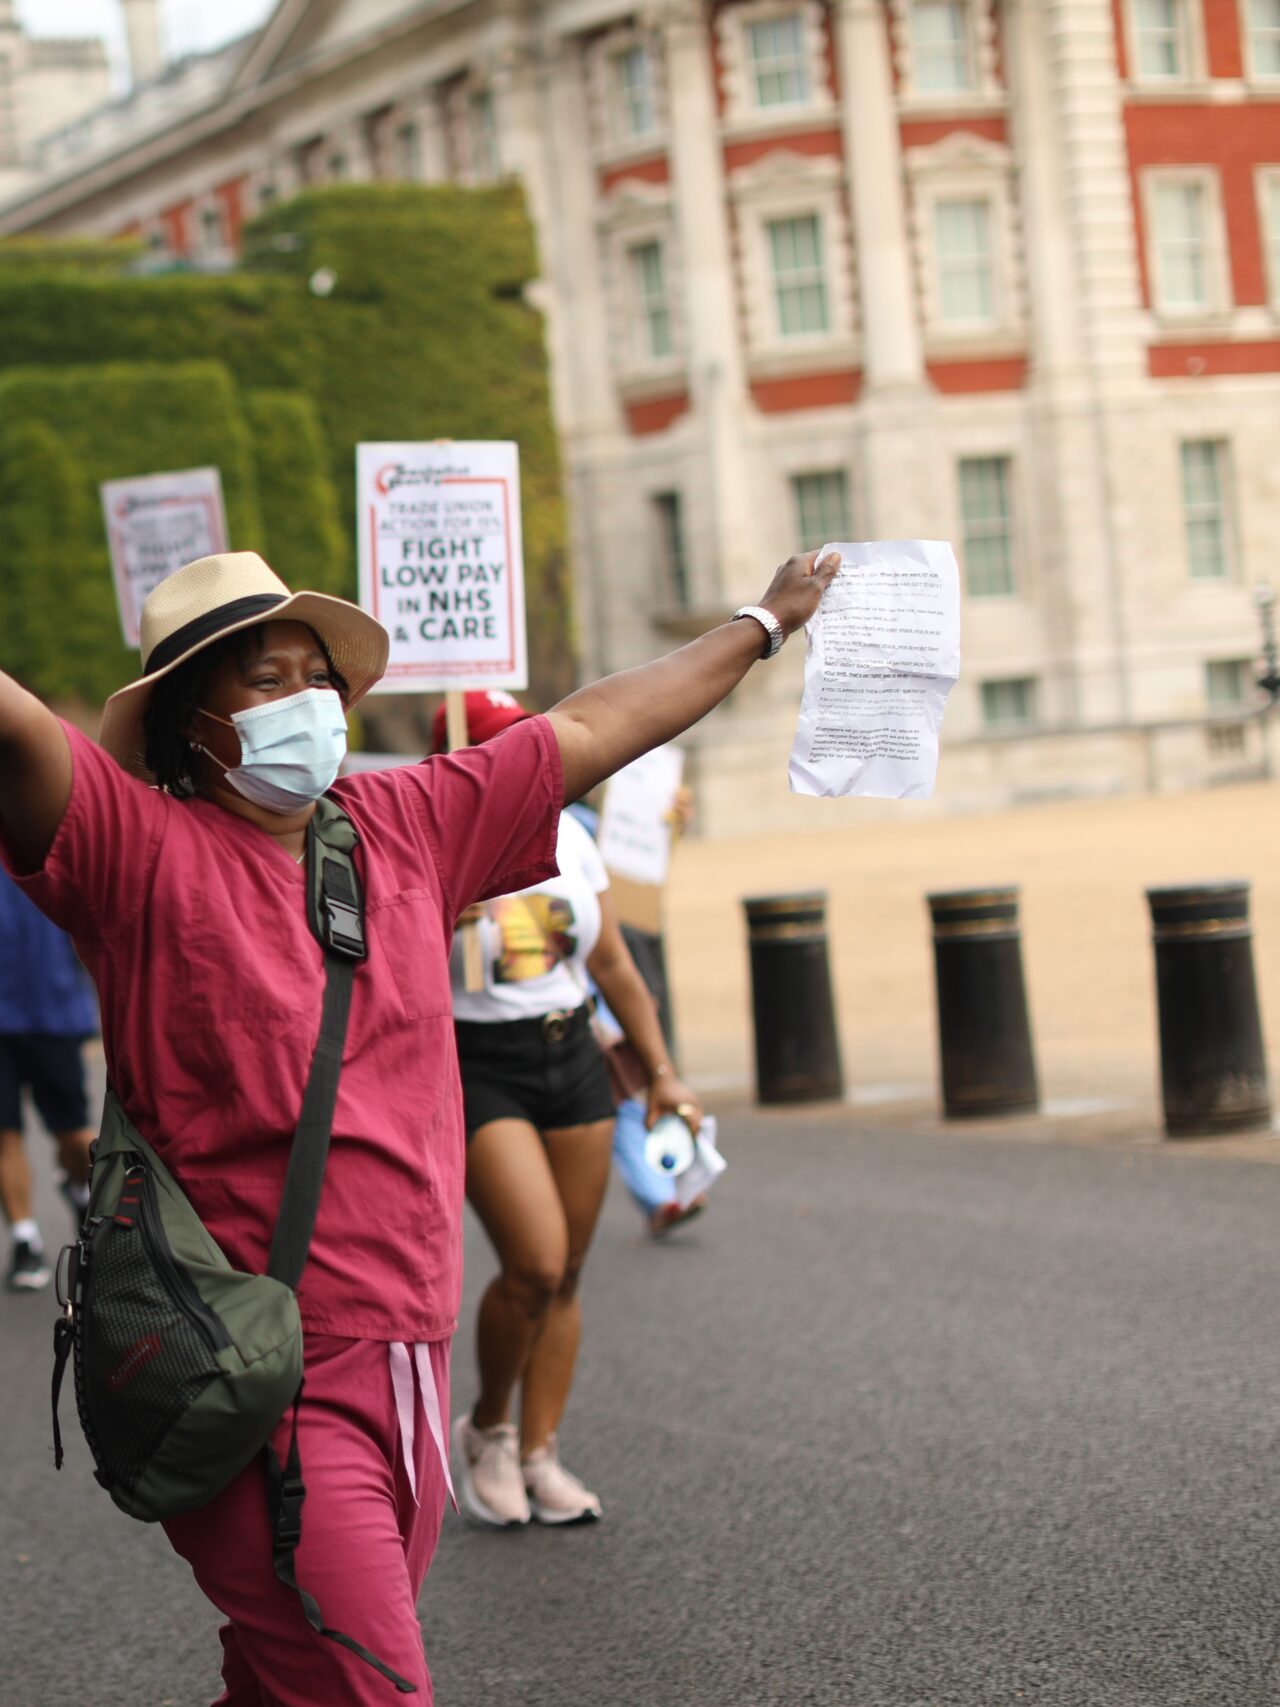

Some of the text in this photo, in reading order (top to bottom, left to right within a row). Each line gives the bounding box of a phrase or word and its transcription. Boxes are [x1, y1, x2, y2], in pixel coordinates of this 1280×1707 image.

[402, 537, 485, 560] FIGHT
[381, 562, 505, 588] LOW PAY
[398, 589, 492, 614] IN NHS
[420, 616, 497, 641] CARE
